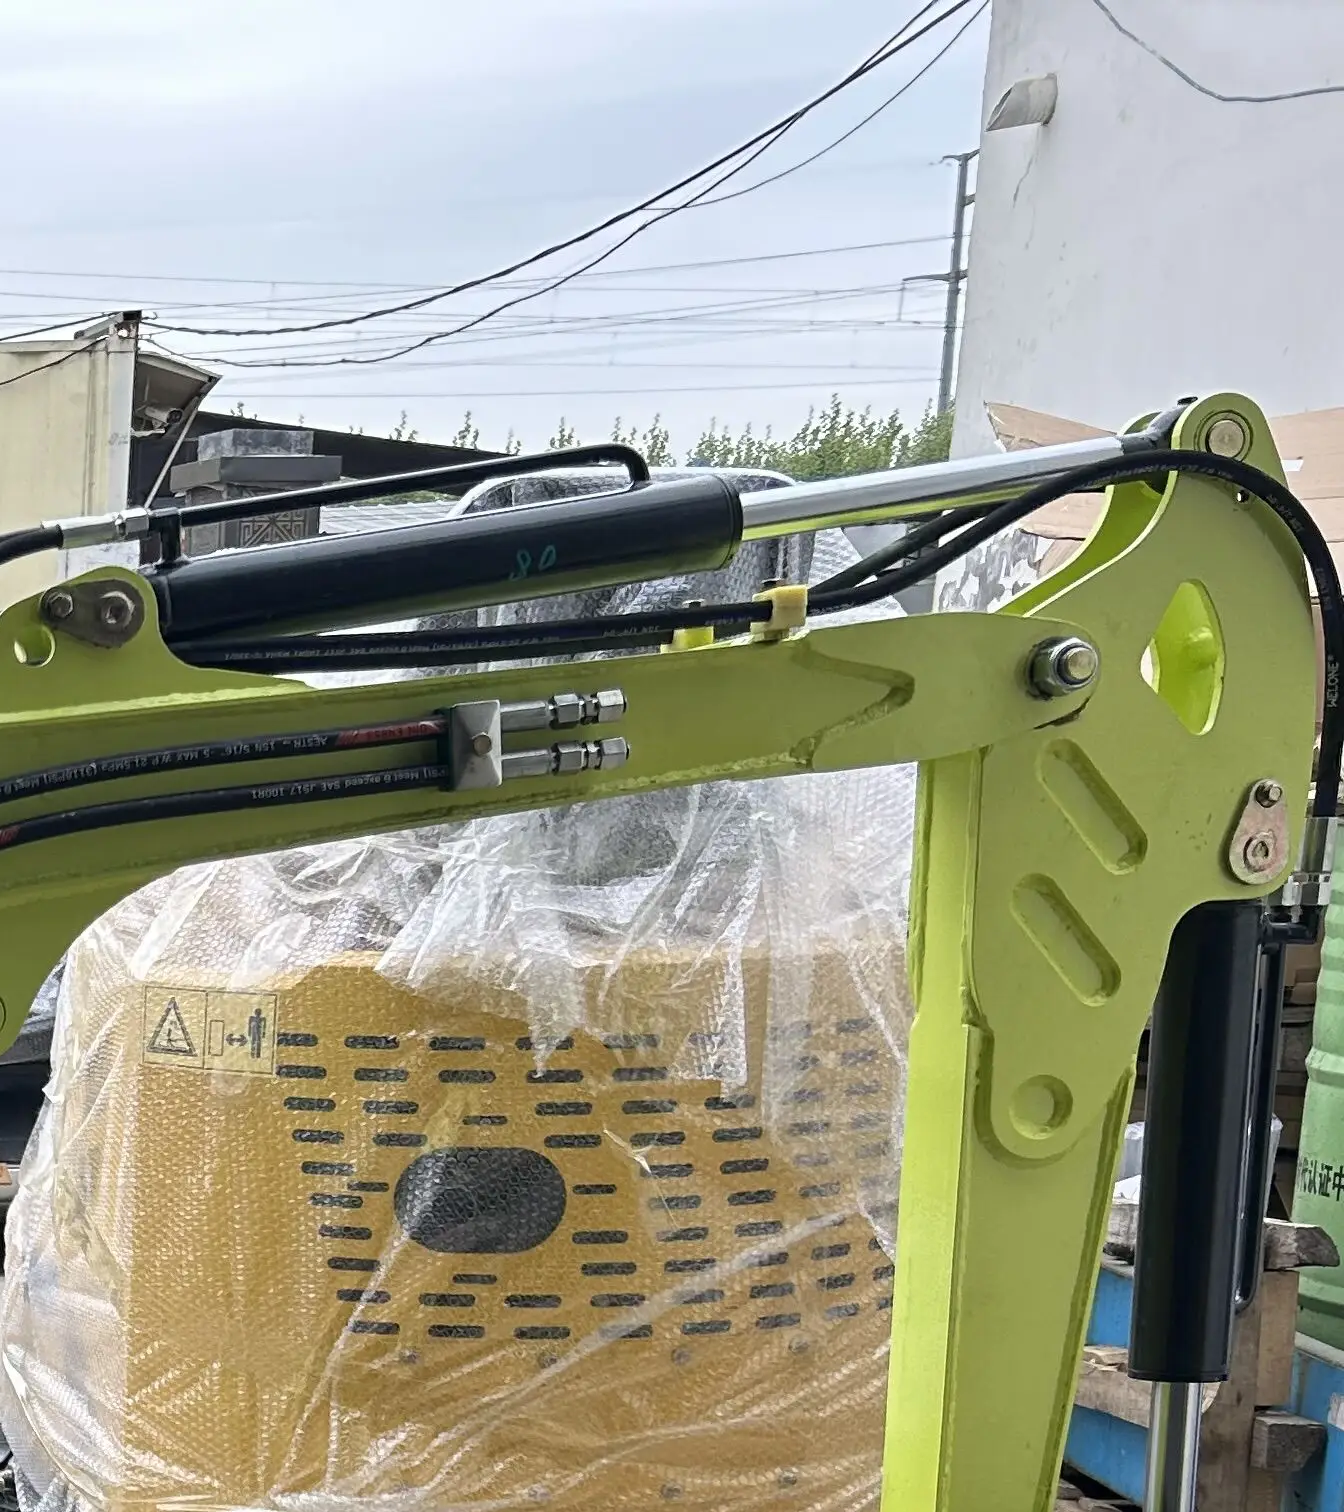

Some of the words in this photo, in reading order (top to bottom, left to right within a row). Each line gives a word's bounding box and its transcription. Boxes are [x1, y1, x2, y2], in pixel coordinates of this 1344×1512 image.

[319, 777, 340, 791] SAE
[342, 771, 381, 789] exceed
[250, 783, 285, 801] 100R1
